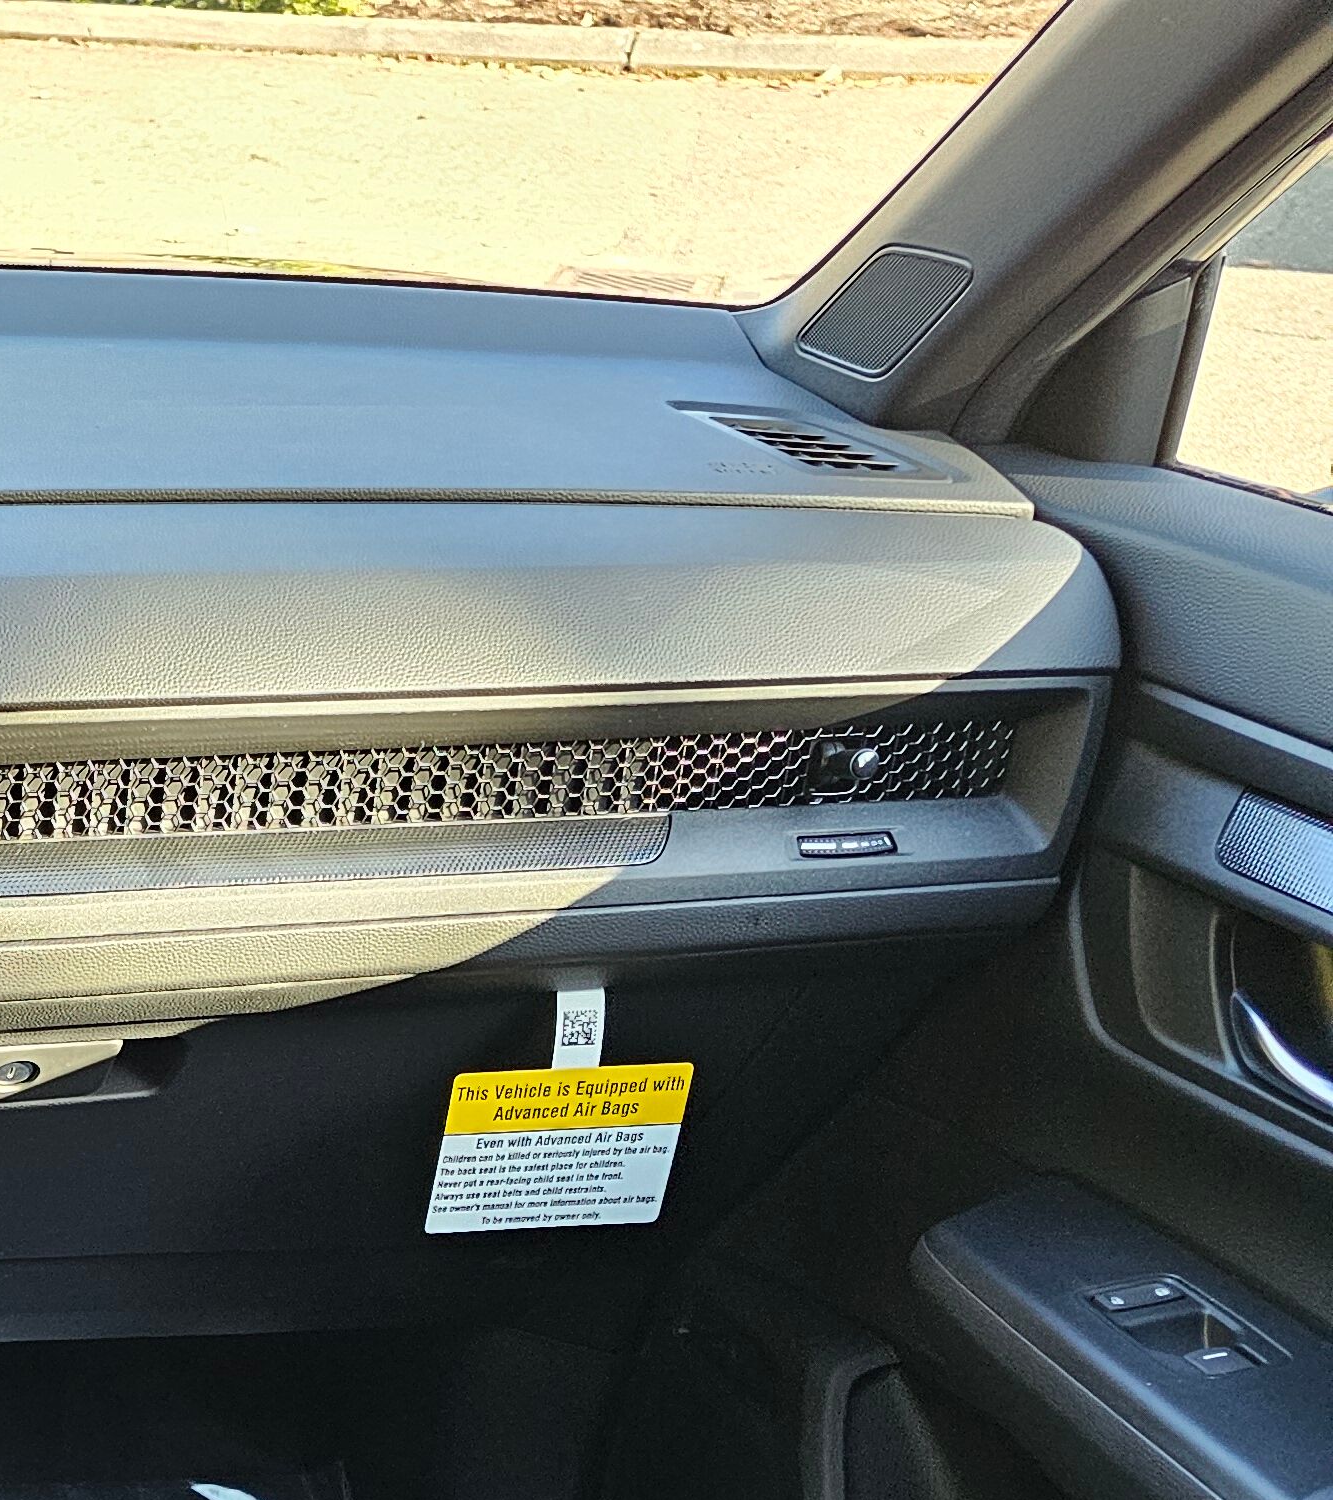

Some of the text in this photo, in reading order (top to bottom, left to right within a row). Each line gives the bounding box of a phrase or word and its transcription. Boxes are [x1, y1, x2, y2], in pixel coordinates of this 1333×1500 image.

[458, 1075, 685, 1102] This Vehicle is Equipped with
[493, 1101, 640, 1121] Advanced Air Bags
[476, 1131, 645, 1150] Even with Advanced Air Bags
[442, 1155, 476, 1164] Children
[495, 1153, 505, 1161] be
[507, 1151, 531, 1161] killed
[542, 1149, 580, 1159] seriously
[581, 1147, 611, 1158] injured
[612, 1147, 622, 1157] by
[624, 1146, 637, 1154] the
[638, 1146, 651, 1154] air
[652, 1145, 670, 1155] bag.
[440, 1160, 625, 1177] The back seat is the safest place for children.
[437, 1180, 462, 1189] Never
[463, 1179, 477, 1189] put
[485, 1177, 532, 1187] rear-facing
[533, 1174, 554, 1183] child
[556, 1174, 573, 1183] seat
[586, 1173, 599, 1181] the
[601, 1172, 624, 1180] front.
[434, 1185, 607, 1202] Always use seat belts and child restraints.
[431, 1205, 448, 1214] See
[449, 1203, 481, 1212] owner's
[482, 1202, 513, 1211] manual
[514, 1200, 526, 1209] for
[549, 1198, 597, 1207] information
[598, 1196, 622, 1205] about
[622, 1195, 635, 1203] air
[635, 1195, 658, 1204] bags.
[481, 1211, 601, 1225] To be removed by owner only.
